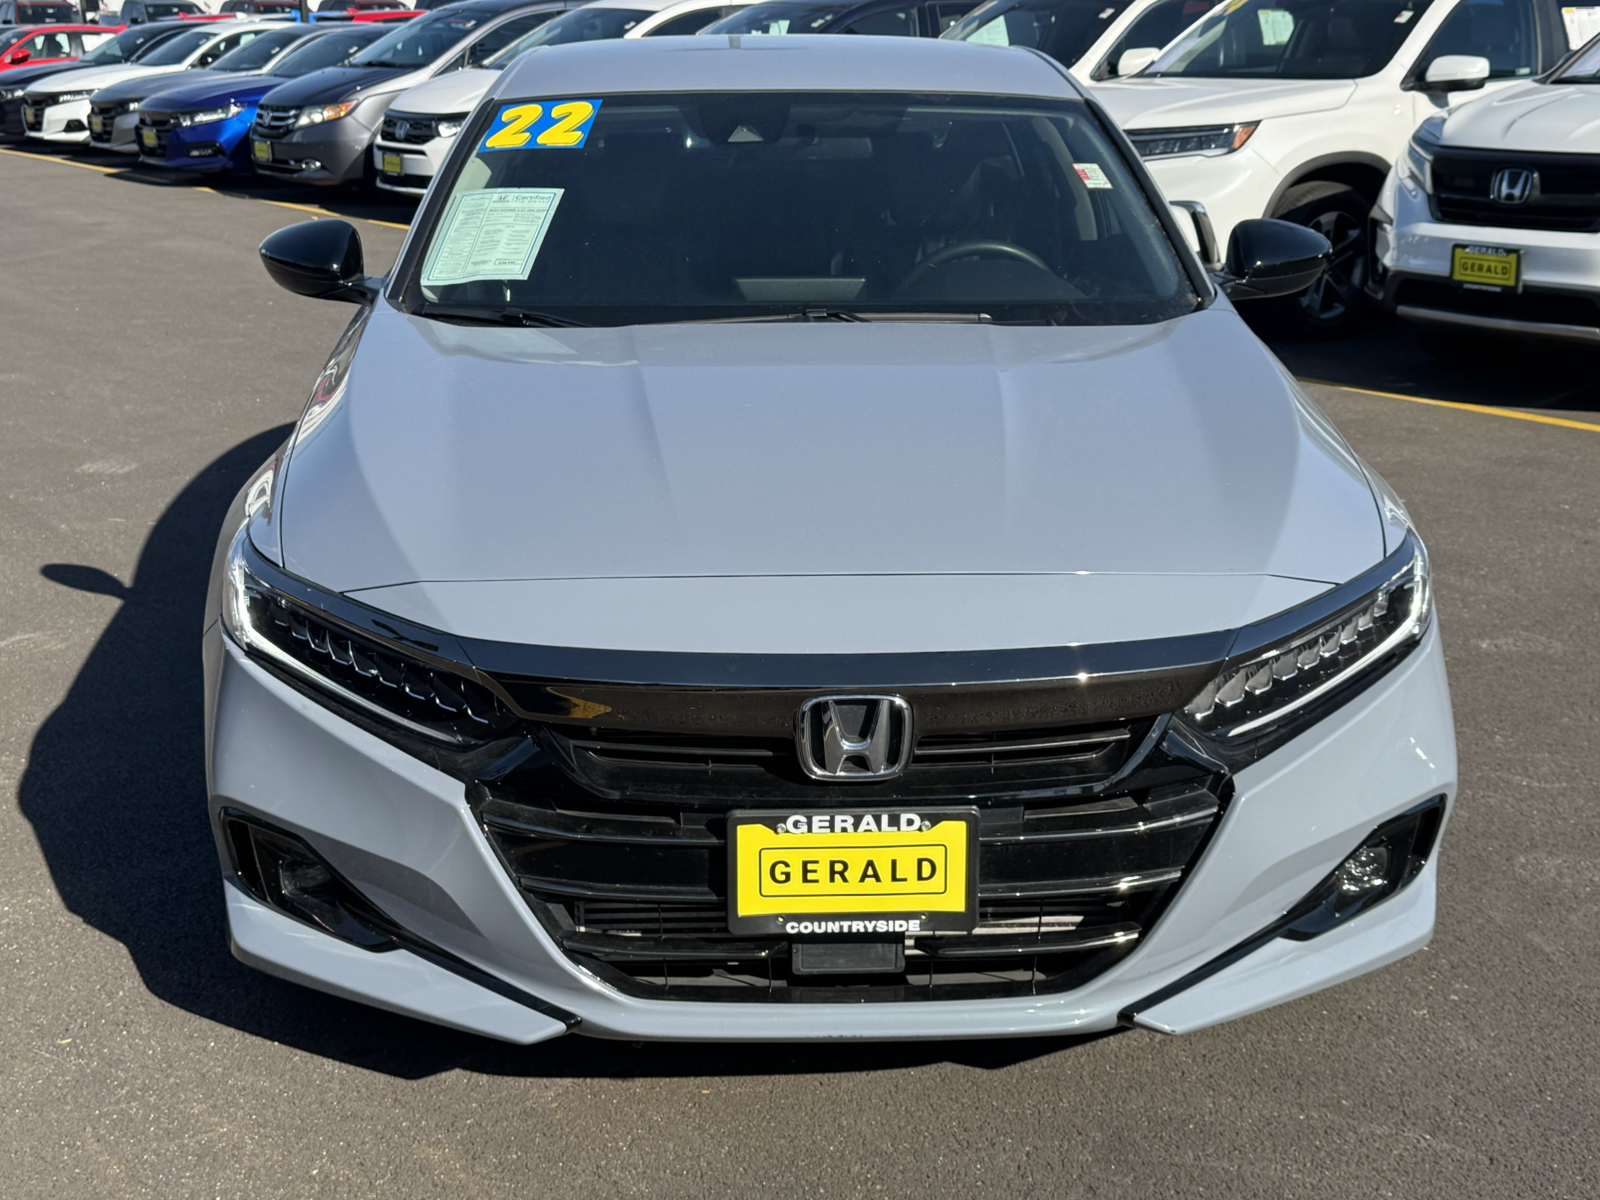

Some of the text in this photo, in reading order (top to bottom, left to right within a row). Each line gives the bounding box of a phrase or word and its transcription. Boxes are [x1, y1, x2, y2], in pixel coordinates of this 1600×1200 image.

[485, 101, 594, 149] 22
[1462, 262, 1508, 275] GERALD
[785, 813, 921, 834] GERALD
[769, 858, 937, 884] GERALD
[785, 920, 921, 934] COUNTRYSIDE
